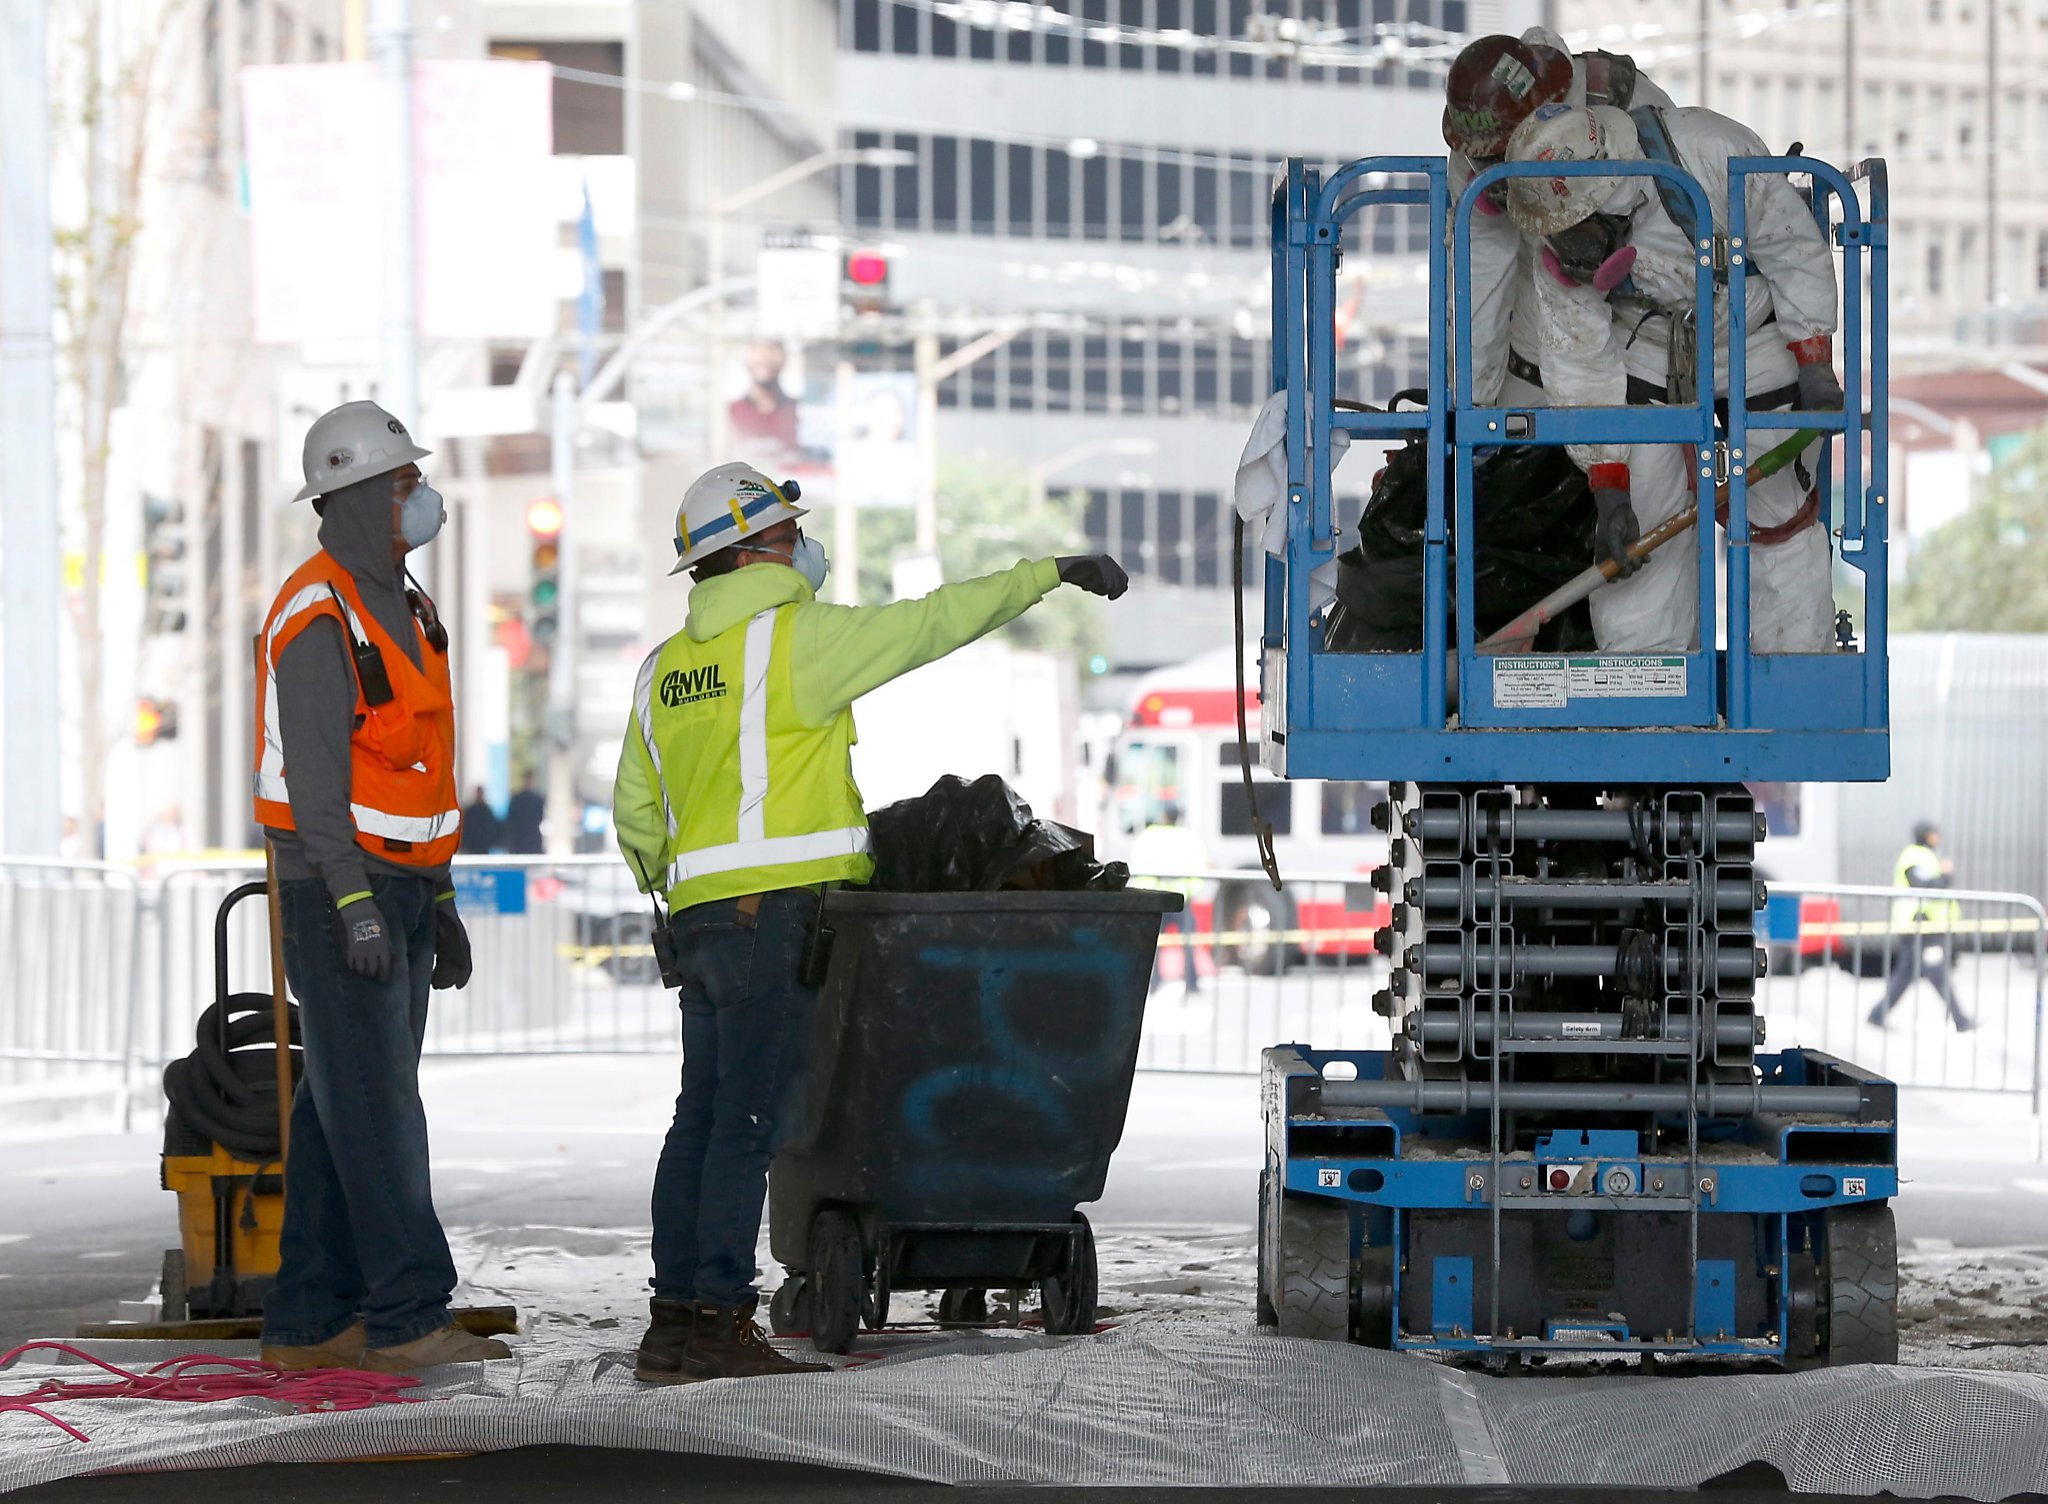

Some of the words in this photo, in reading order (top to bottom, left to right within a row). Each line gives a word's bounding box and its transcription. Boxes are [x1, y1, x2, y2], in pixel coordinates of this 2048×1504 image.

[1498, 661, 1560, 669] INSTRUCTIONS
[1599, 659, 1663, 667] INSTRUCTIONS
[661, 664, 726, 708] ANVIL
